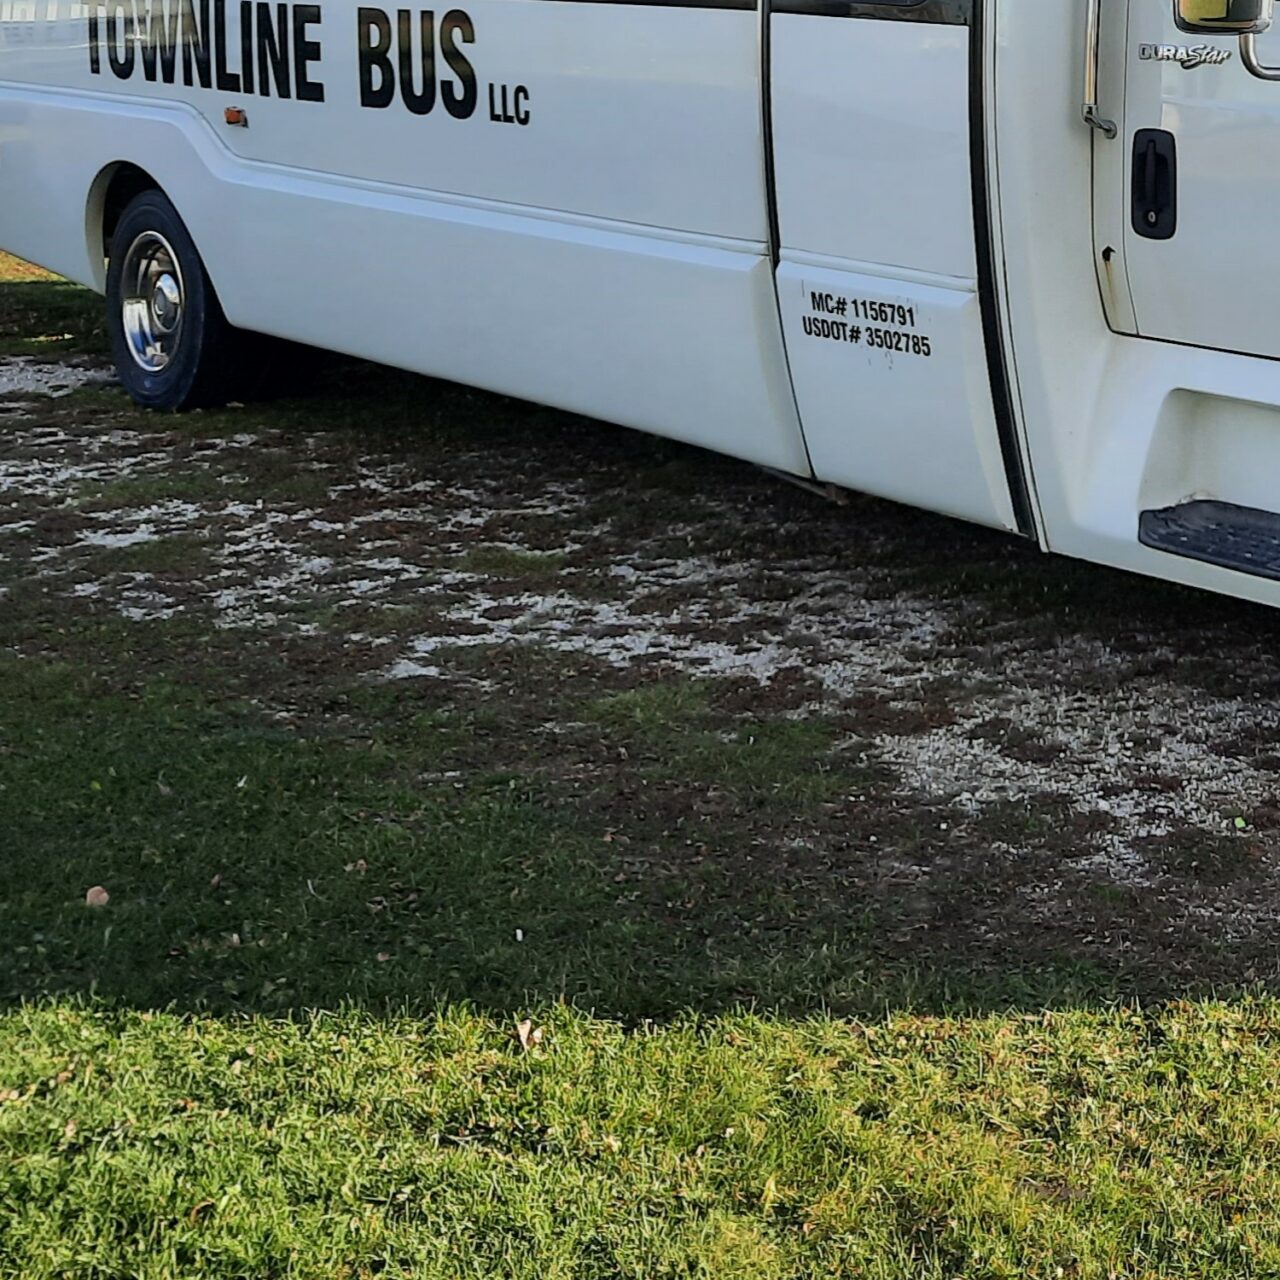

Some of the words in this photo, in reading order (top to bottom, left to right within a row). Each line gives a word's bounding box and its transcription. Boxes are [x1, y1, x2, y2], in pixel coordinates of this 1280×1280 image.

[357, 7, 477, 119] BUS
[488, 82, 531, 125] LLC
[811, 291, 847, 316] MC#
[851, 299, 914, 327] 1156791
[802, 315, 862, 344] USDOT#
[865, 327, 931, 356] 3502785
